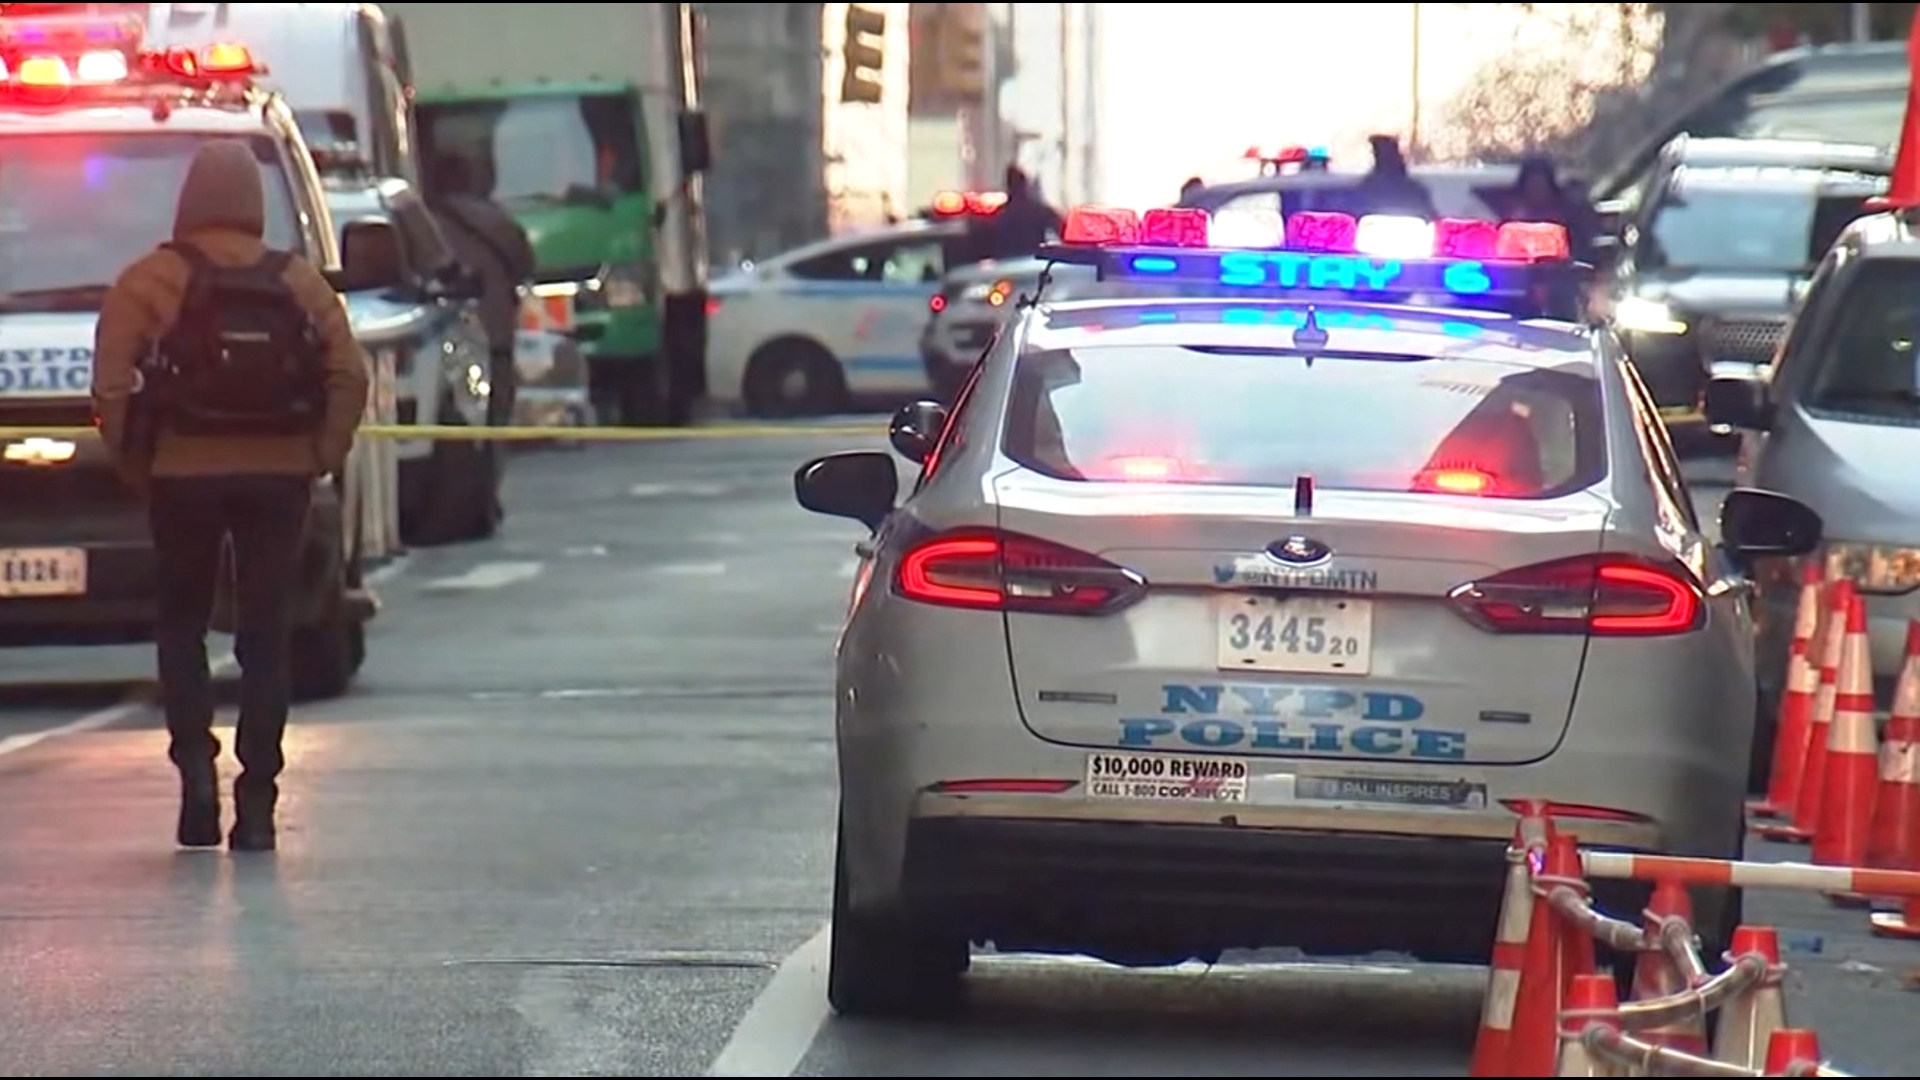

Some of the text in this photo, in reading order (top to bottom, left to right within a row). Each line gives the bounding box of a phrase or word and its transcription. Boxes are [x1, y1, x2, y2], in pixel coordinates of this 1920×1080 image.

[1220, 254, 1491, 293] STAY 6
[1230, 613, 1358, 656] 3445 20
[1161, 684, 1425, 722] NYPD
[1118, 718, 1466, 758] POLICE
[1093, 756, 1245, 779] $10,000 REWARD
[1093, 782, 1121, 797] CALL
